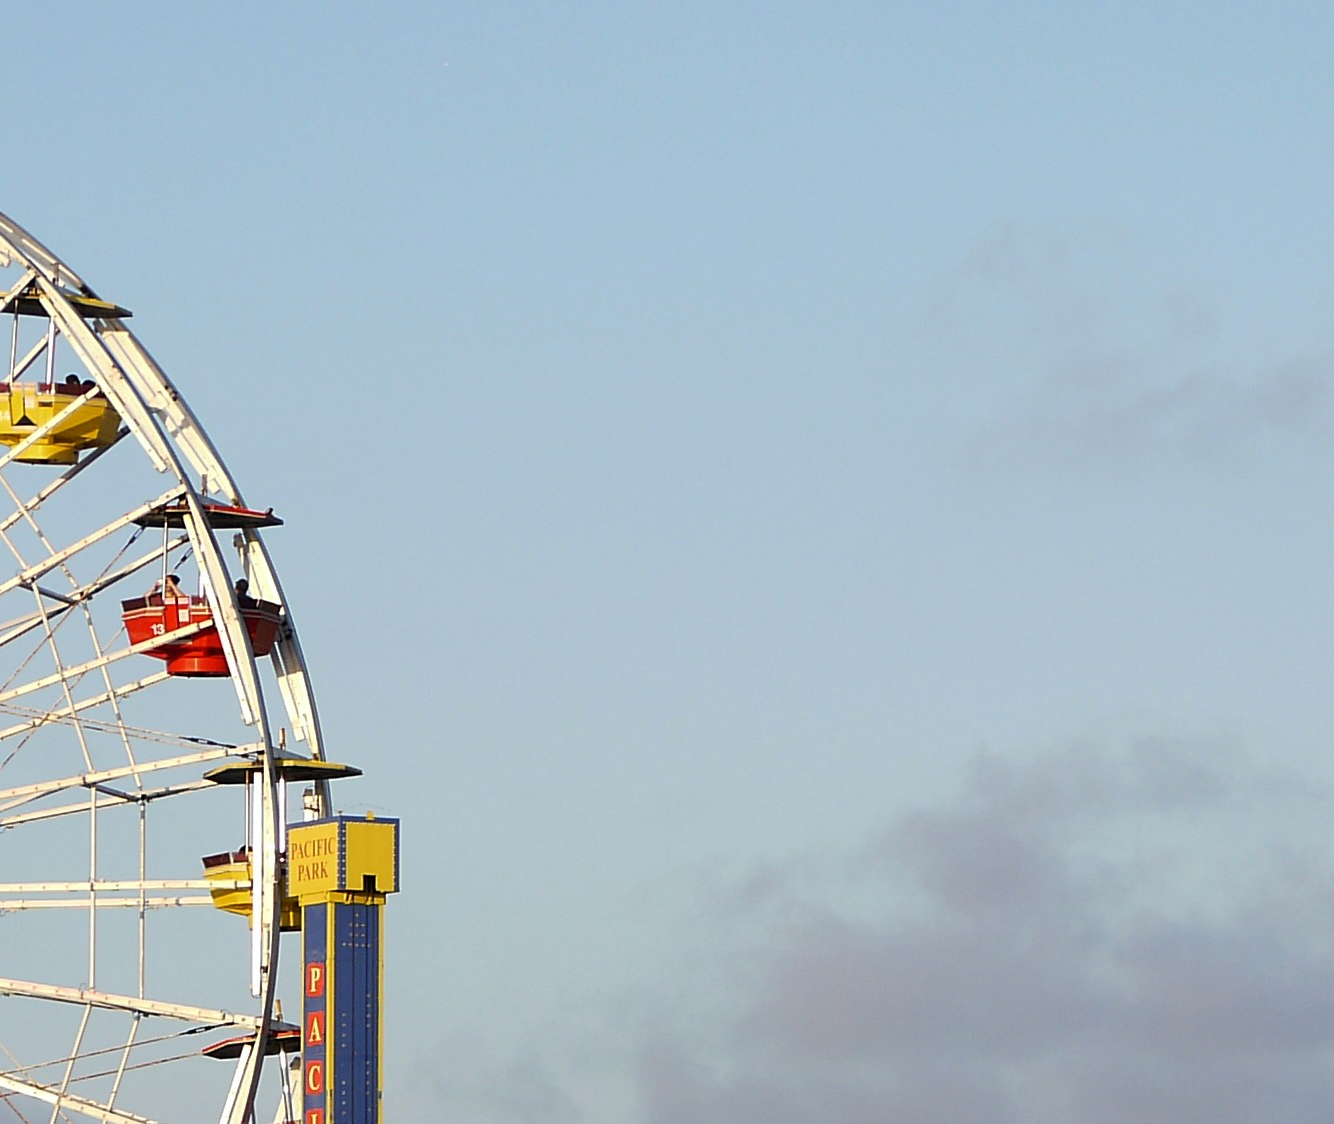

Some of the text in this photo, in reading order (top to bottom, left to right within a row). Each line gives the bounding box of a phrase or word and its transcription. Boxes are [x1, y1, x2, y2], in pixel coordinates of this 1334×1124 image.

[150, 623, 165, 636] 13
[291, 836, 335, 860] PACIFIC
[297, 860, 329, 882] PARK
